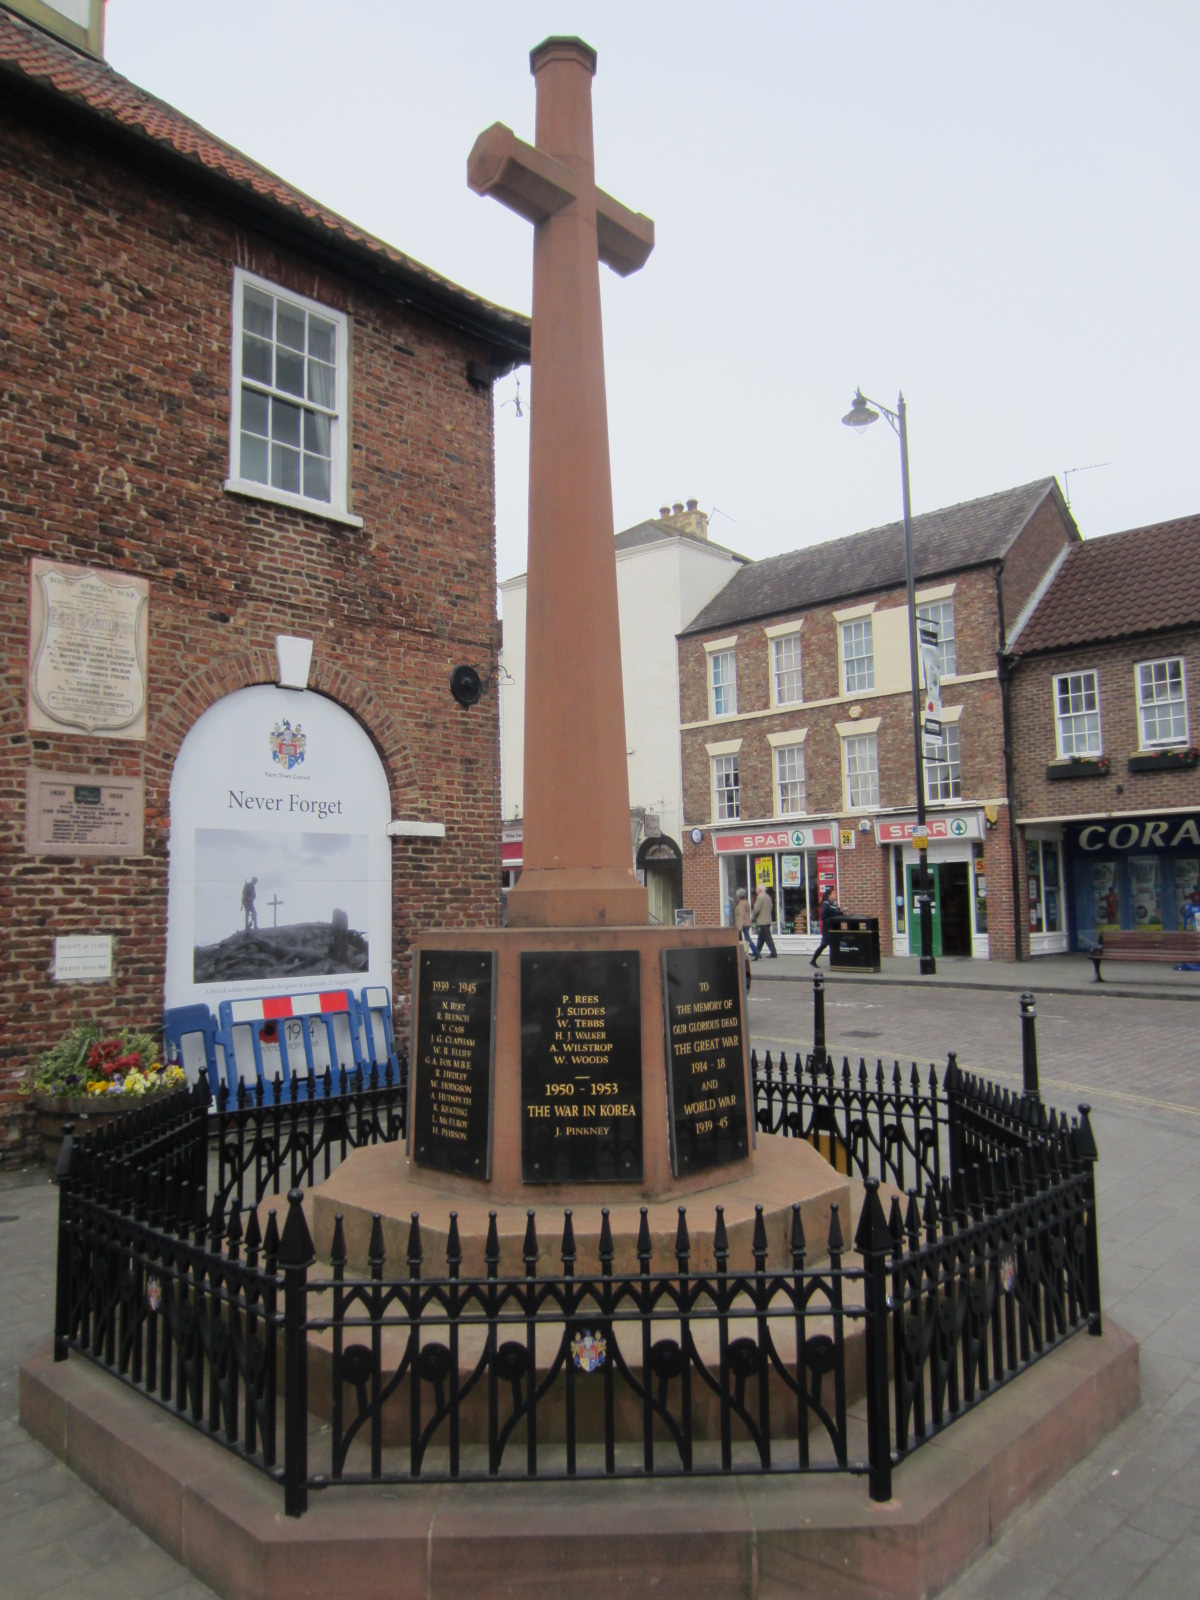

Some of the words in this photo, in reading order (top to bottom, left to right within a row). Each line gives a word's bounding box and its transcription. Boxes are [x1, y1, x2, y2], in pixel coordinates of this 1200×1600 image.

[81, 583, 112, 594] AFRICAN
[227, 789, 283, 811] Never
[288, 793, 343, 820] Forget
[743, 834, 789, 848] SPAR
[432, 981, 450, 992] 1939
[458, 982, 477, 994] 1945
[699, 981, 709, 992] TO
[562, 995, 571, 1004] P.
[574, 995, 599, 1004] REES
[450, 1002, 466, 1011] BEST
[556, 1007, 564, 1018] J.
[567, 1007, 606, 1016] SUDDES
[676, 1004, 691, 1015] THE
[693, 1001, 722, 1013] MEMORY
[723, 999, 733, 1009] OF
[449, 1024, 465, 1034] CASS
[557, 1019, 571, 1028] W.
[574, 1019, 605, 1028] TEBBS
[672, 1023, 687, 1035] OUR
[688, 1019, 720, 1033] GLORIOUS
[721, 1017, 738, 1028] DEAD
[286, 1020, 315, 1041] 194
[575, 1031, 606, 1040] WALKER
[549, 1043, 559, 1053] A.
[562, 1043, 613, 1052] WILSTROP
[673, 1042, 692, 1056] THE
[693, 1038, 720, 1053] GREAT
[722, 1035, 739, 1048] WAR
[440, 1058, 452, 1068] FOX
[554, 1055, 568, 1064] W.
[571, 1055, 609, 1064] WOODS
[691, 1060, 708, 1074] 1914
[717, 1058, 726, 1070] 18
[443, 1070, 468, 1081] HEDLEY
[441, 1081, 472, 1094] HODGSON
[545, 1083, 575, 1096] 1950
[590, 1083, 619, 1096] 1953
[702, 1079, 719, 1092] AND
[440, 1104, 468, 1117] KEATING
[527, 1105, 551, 1118] THE
[554, 1105, 579, 1117] WAR
[583, 1104, 596, 1117] IN
[600, 1104, 636, 1117] KOREA
[683, 1098, 716, 1116] WORLD
[718, 1094, 736, 1108] WAR
[441, 1127, 468, 1141] PEIRSON
[554, 1126, 562, 1138] J.
[566, 1126, 610, 1136] PINKNEY
[696, 1120, 713, 1135] 1939
